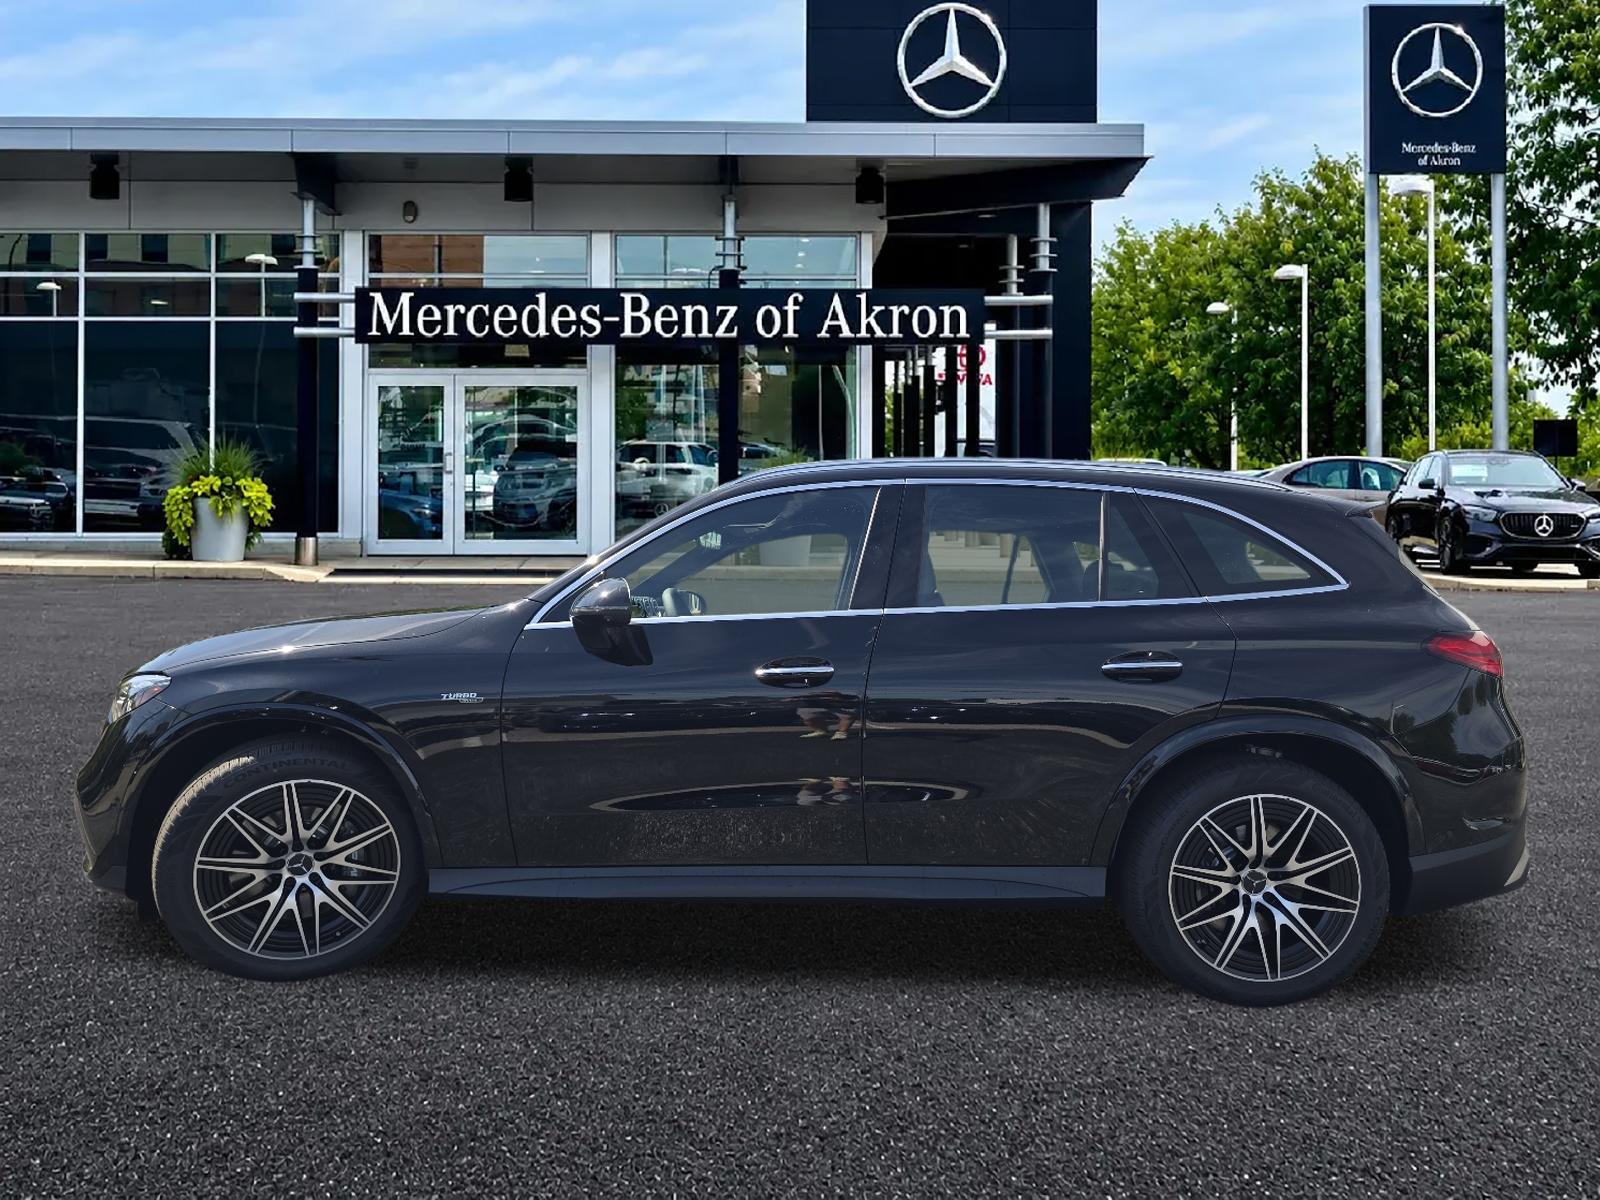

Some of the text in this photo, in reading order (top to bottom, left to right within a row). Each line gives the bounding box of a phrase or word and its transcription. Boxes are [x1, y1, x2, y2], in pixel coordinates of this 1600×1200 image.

[1401, 142, 1476, 153] Mercedes-Benz
[1418, 154, 1460, 166] of Akron
[367, 291, 970, 338] Mercedes-Benz of Akron
